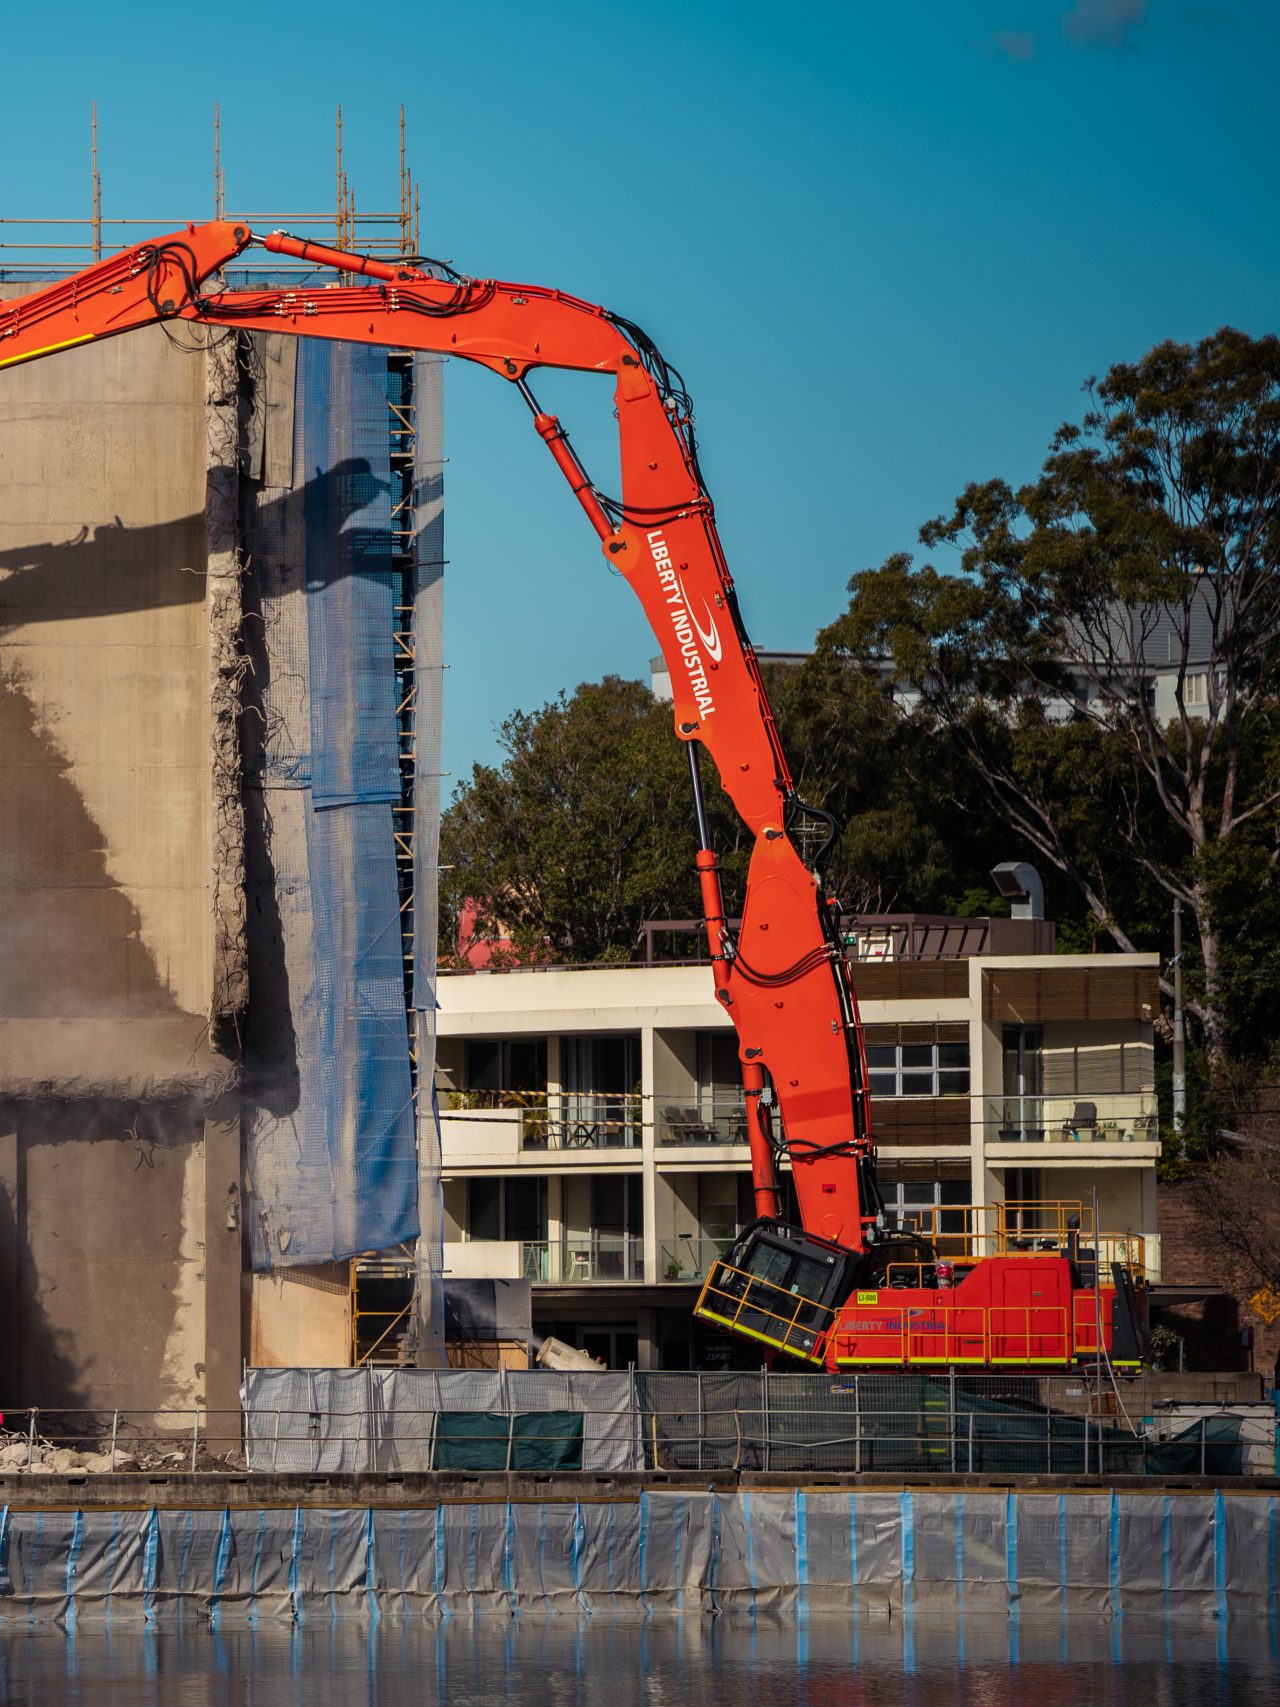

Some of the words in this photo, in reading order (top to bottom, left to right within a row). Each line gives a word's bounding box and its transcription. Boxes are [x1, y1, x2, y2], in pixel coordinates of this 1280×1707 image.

[646, 530, 683, 604] LIBERTY
[671, 609, 716, 721] INDUSTRIAL
[838, 1321, 883, 1331] LIBERTY
[885, 1321, 951, 1330] INDUSTRIA
